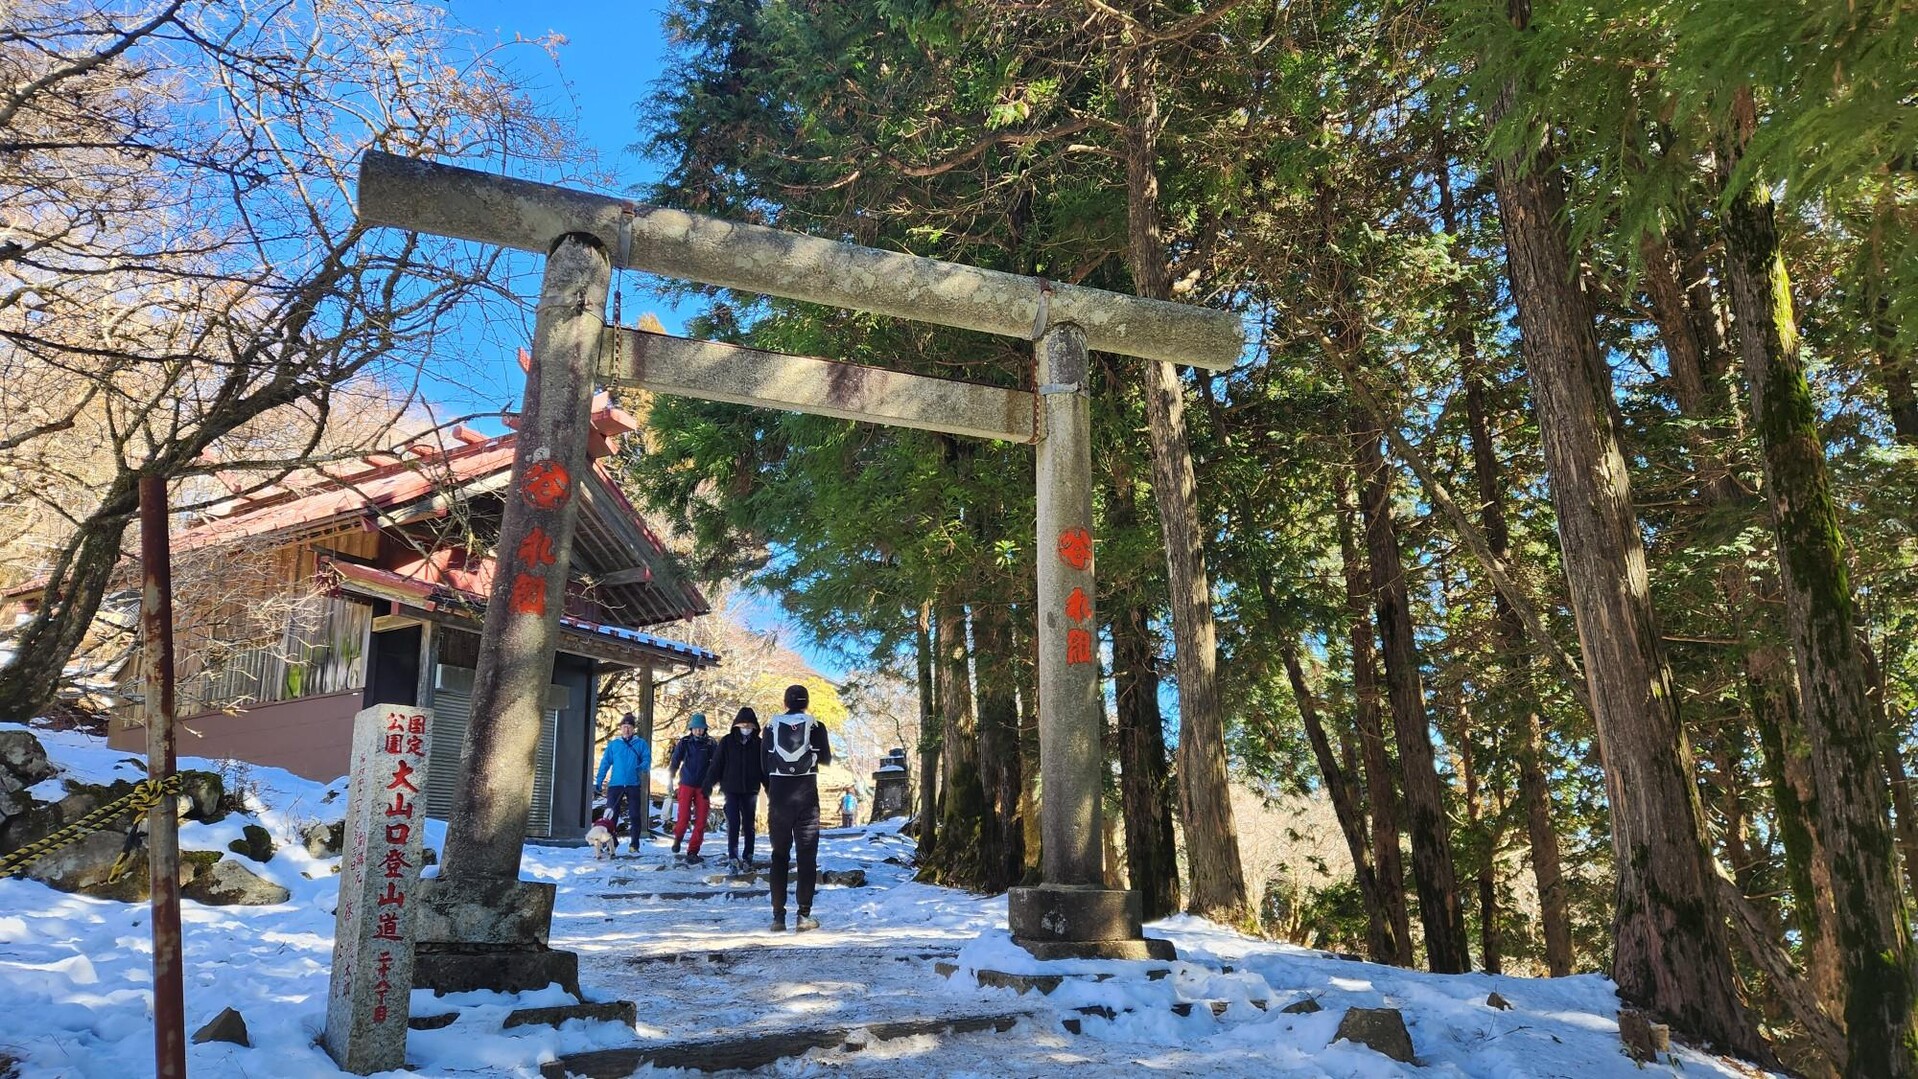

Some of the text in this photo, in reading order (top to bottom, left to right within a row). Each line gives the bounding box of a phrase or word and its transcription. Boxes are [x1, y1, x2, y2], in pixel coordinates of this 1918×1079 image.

[372, 759, 420, 942] 大山口登山道
